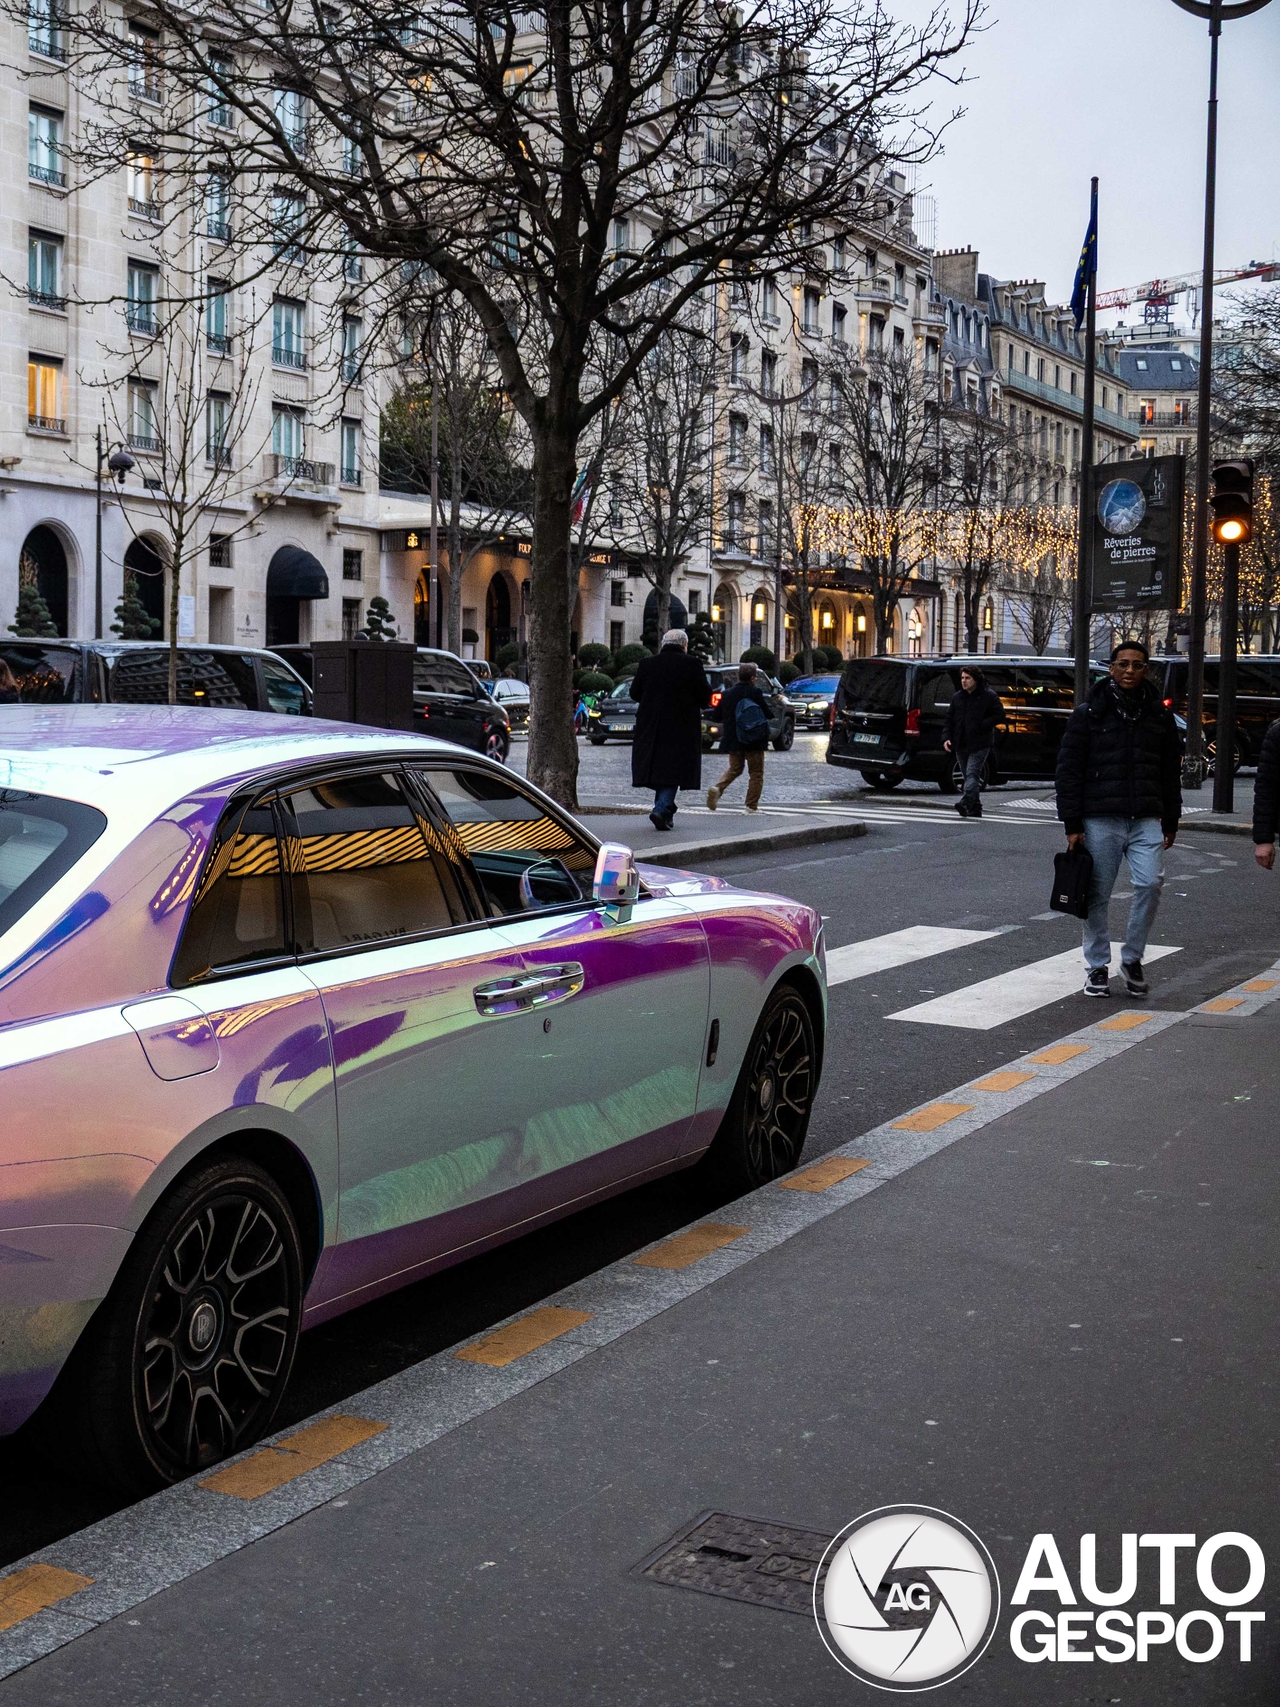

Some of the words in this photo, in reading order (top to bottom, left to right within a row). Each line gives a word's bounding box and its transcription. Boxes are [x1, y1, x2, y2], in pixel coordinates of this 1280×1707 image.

[1104, 535, 1141, 549] Rêveries
[1110, 548, 1121, 559] de
[1123, 546, 1156, 560] pierres
